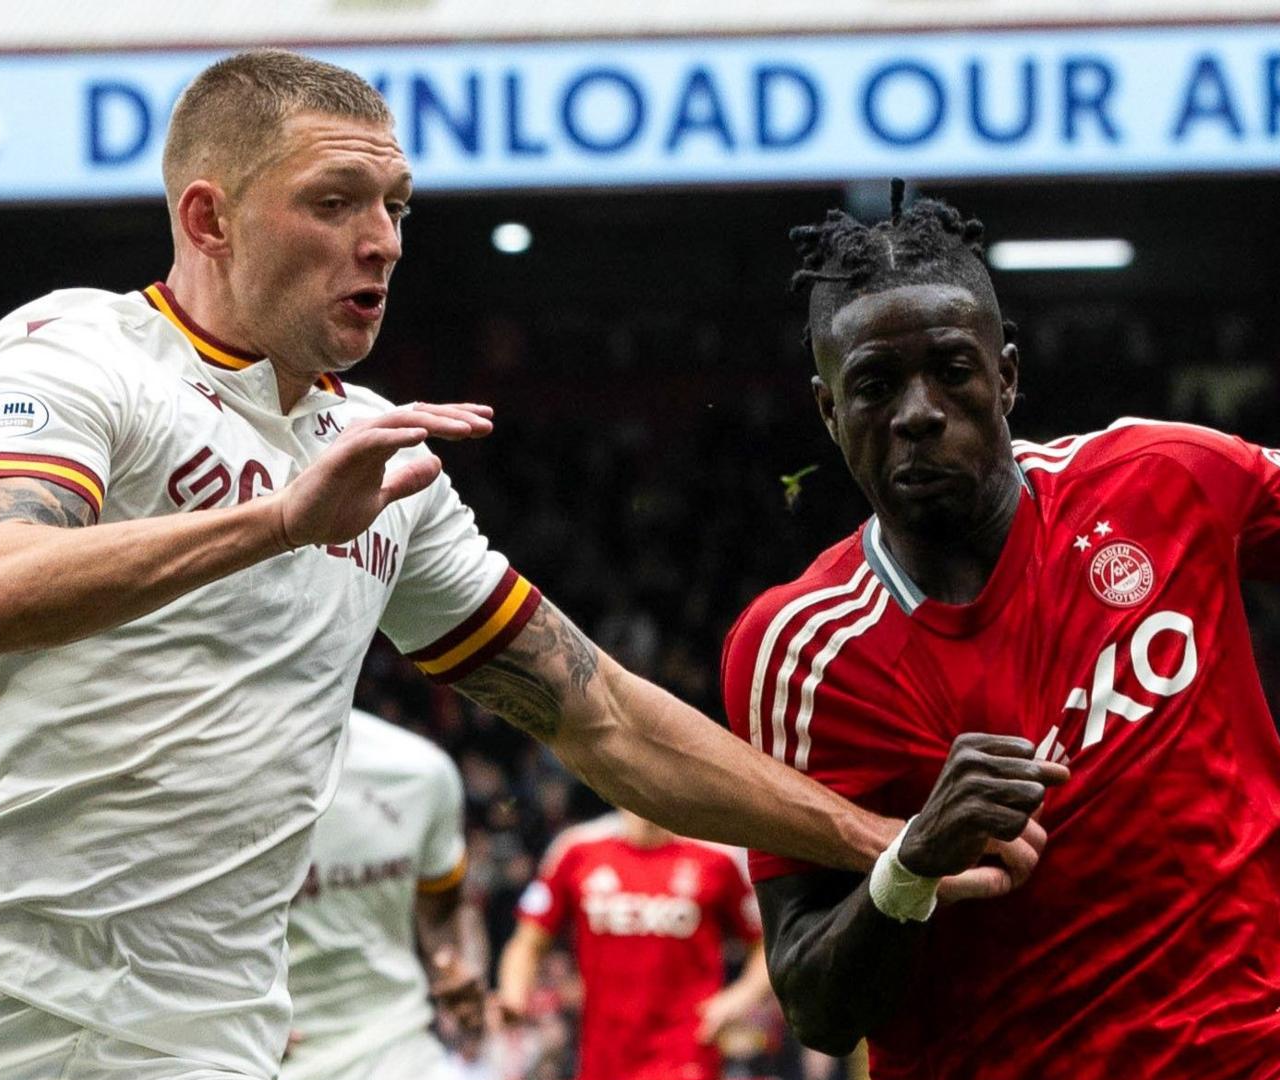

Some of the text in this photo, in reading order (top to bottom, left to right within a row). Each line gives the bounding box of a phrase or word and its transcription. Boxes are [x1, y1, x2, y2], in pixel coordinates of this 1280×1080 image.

[83, 62, 823, 168] DNLOAD
[860, 57, 1123, 148] OUR
[3, 402, 35, 415] HILL
[1093, 547, 1130, 576] ABERDEEN
[1103, 584, 1147, 603] FOOTBALL
[581, 891, 702, 938] TEXO
